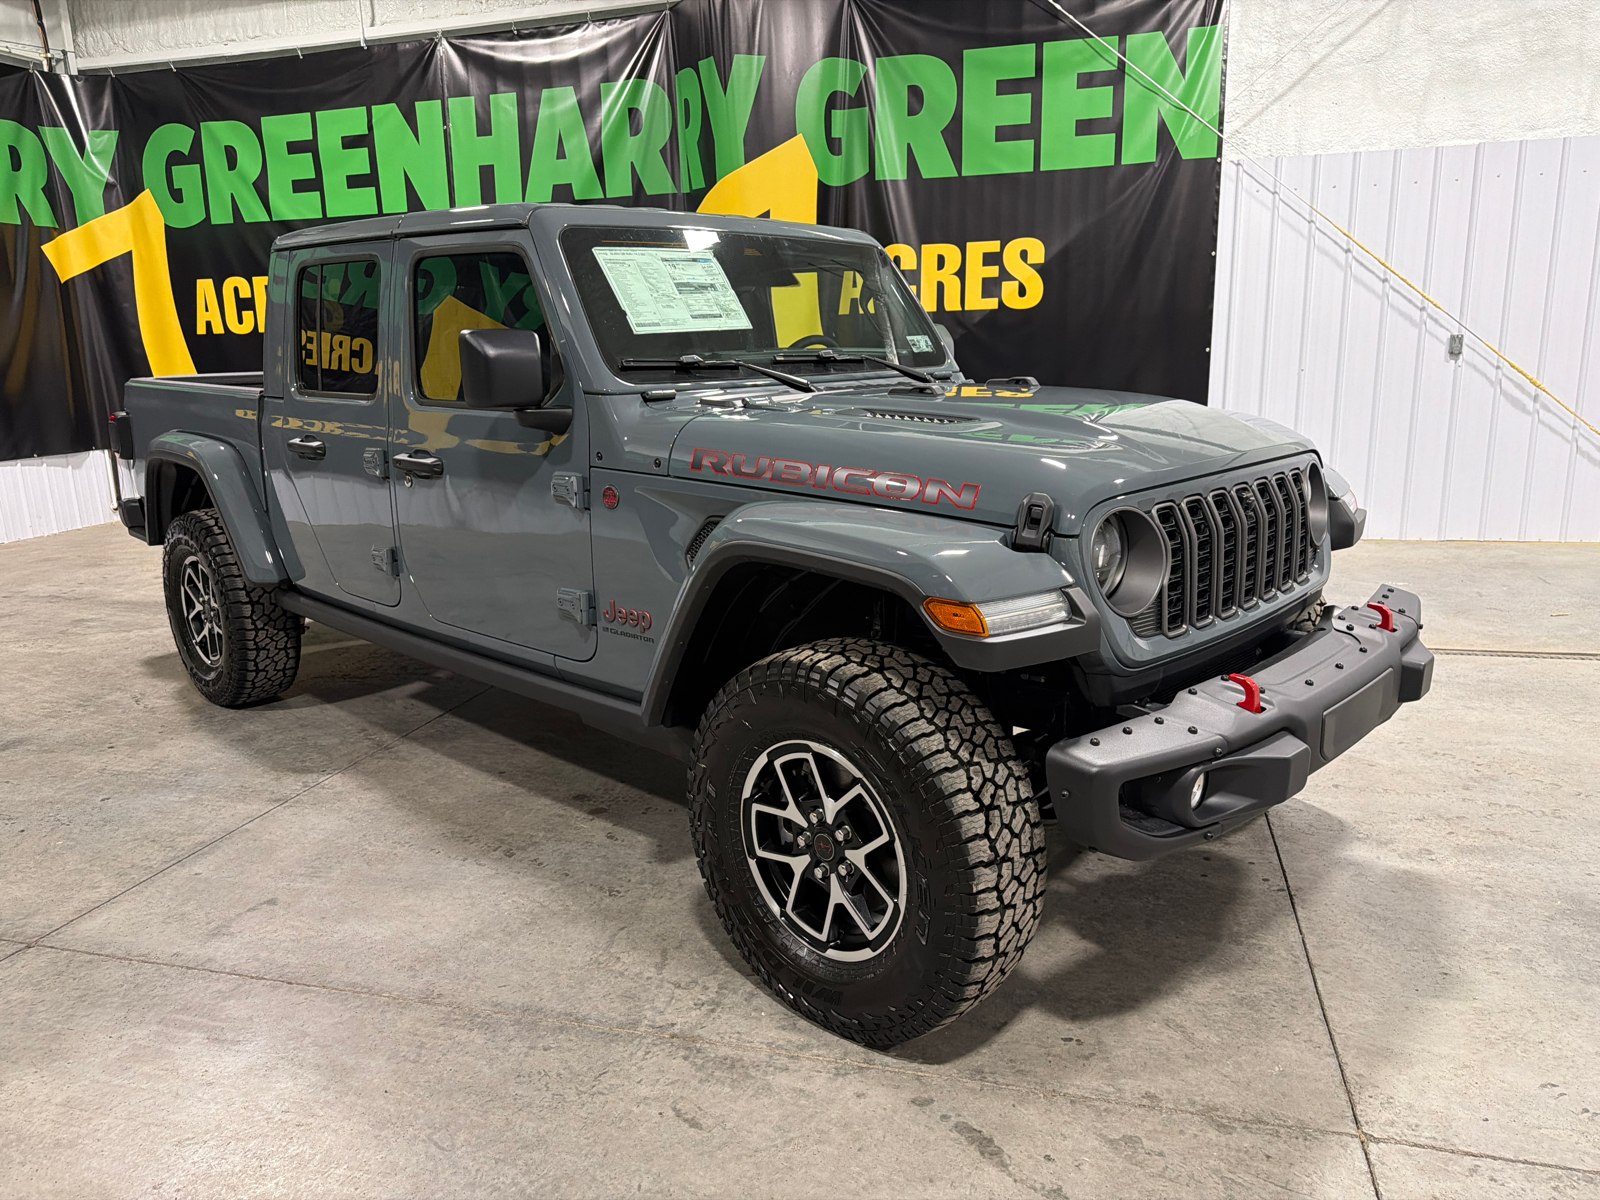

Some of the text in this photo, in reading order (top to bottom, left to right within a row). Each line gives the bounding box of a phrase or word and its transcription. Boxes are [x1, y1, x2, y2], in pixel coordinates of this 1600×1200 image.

[796, 25, 1224, 188] GREEN
[142, 100, 447, 229] GREEN
[690, 447, 981, 510] RUBICON
[602, 599, 652, 634] Jeep
[610, 628, 655, 643] GLADIATOR
